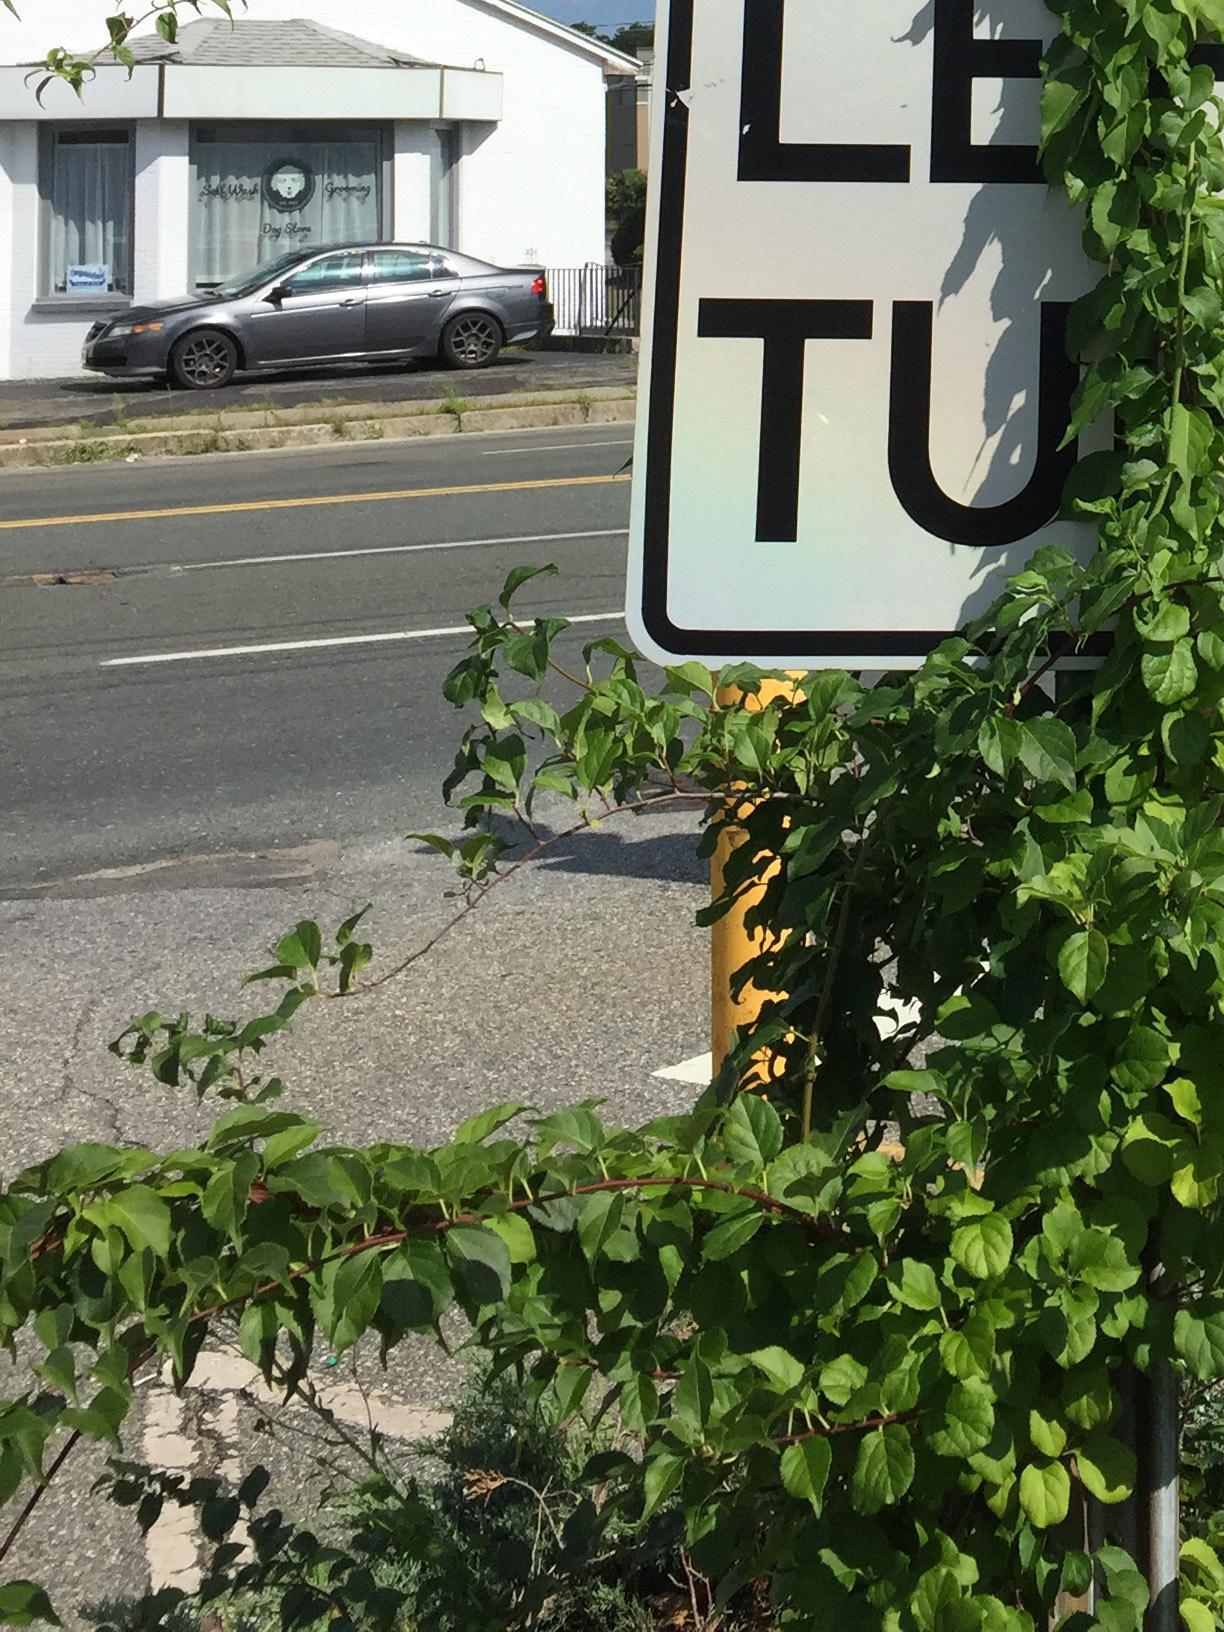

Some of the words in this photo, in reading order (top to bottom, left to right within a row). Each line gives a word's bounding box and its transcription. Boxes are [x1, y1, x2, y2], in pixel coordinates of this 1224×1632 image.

[228, 183, 259, 197] Wash
[325, 182, 371, 196] Grooming
[263, 223, 282, 239] Dog
[284, 222, 312, 235] Store
